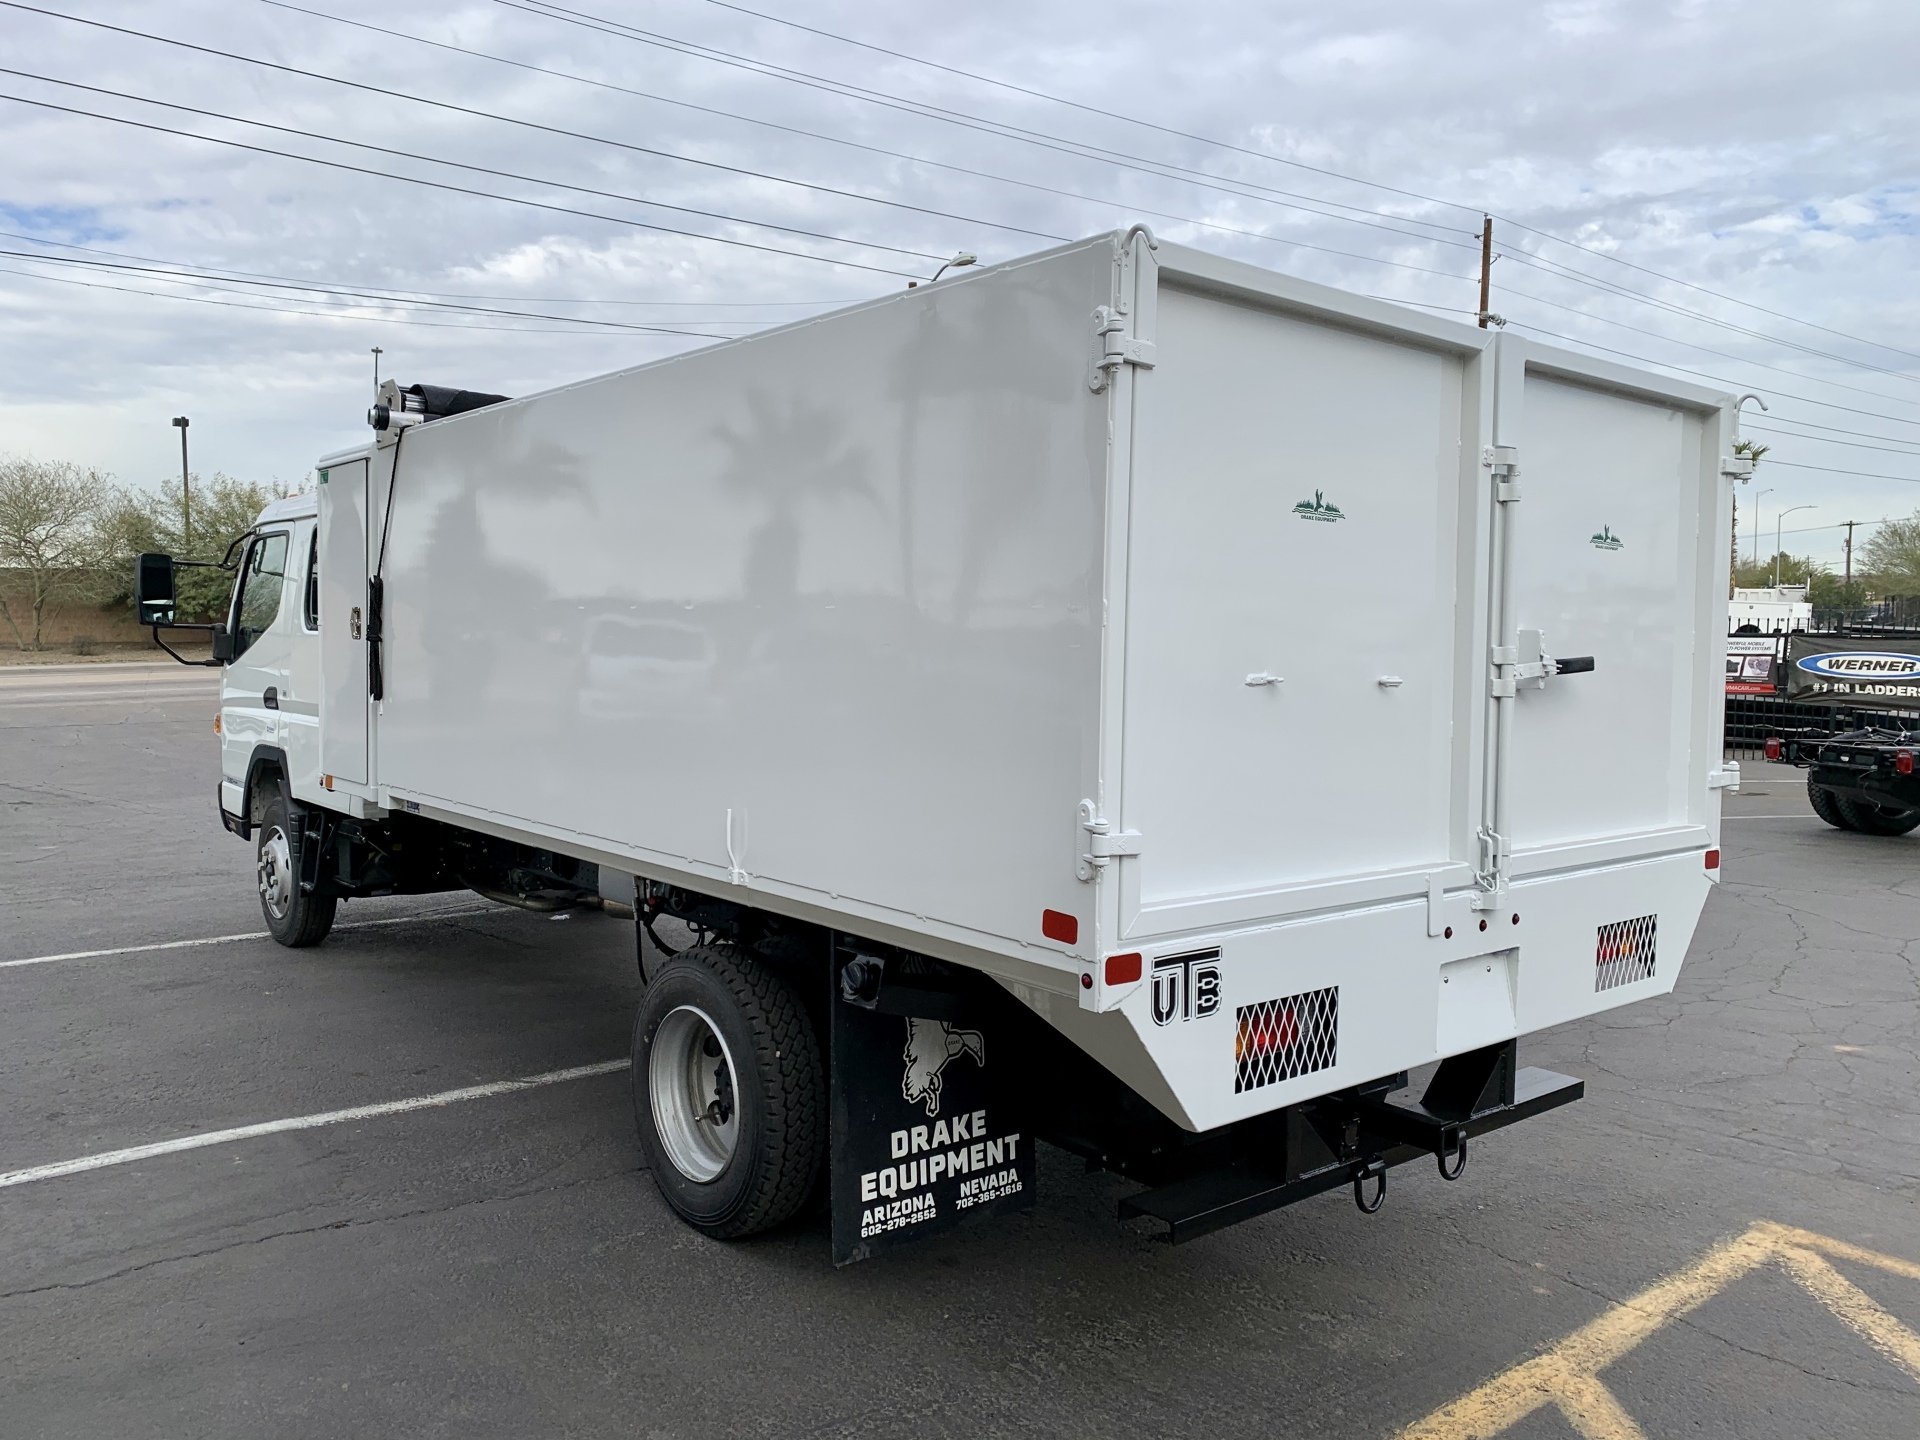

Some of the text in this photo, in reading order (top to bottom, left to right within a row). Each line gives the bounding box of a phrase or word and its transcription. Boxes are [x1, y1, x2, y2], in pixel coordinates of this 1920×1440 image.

[1828, 659, 1917, 672] WERNER
[1812, 682, 1829, 693] #1
[1833, 683, 1851, 693] IN
[891, 1109, 987, 1160] DRAKE
[860, 1133, 1021, 1202] EQUIPMENT
[955, 1181, 1023, 1210] 702-365-1616
[960, 1168, 1018, 1198] NEVADA
[861, 1192, 936, 1227] ARIZONA
[861, 1208, 937, 1238] 602-278-2552
